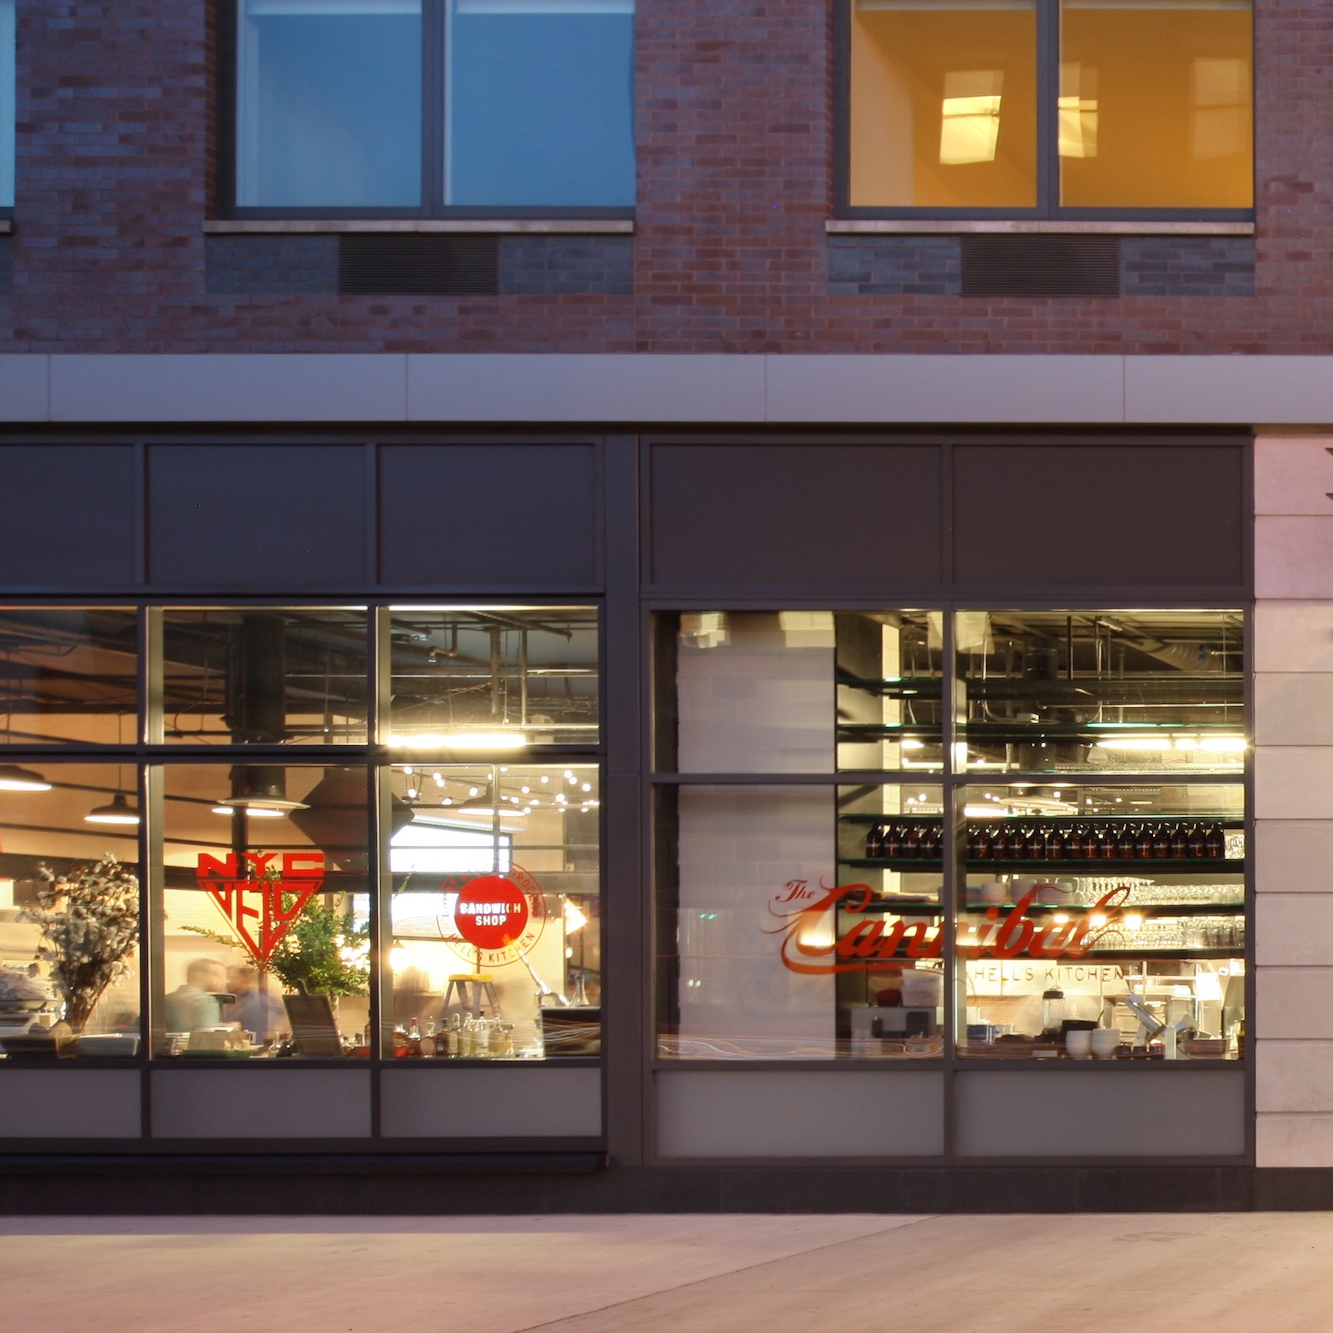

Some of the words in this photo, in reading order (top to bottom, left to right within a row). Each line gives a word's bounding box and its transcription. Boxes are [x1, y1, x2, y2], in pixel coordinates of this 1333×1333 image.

[197, 852, 325, 878] NYC
[774, 879, 815, 902] The
[460, 902, 522, 915] SANDWICH
[475, 915, 508, 927] SHOP
[1044, 966, 1125, 982] KITCHEN
